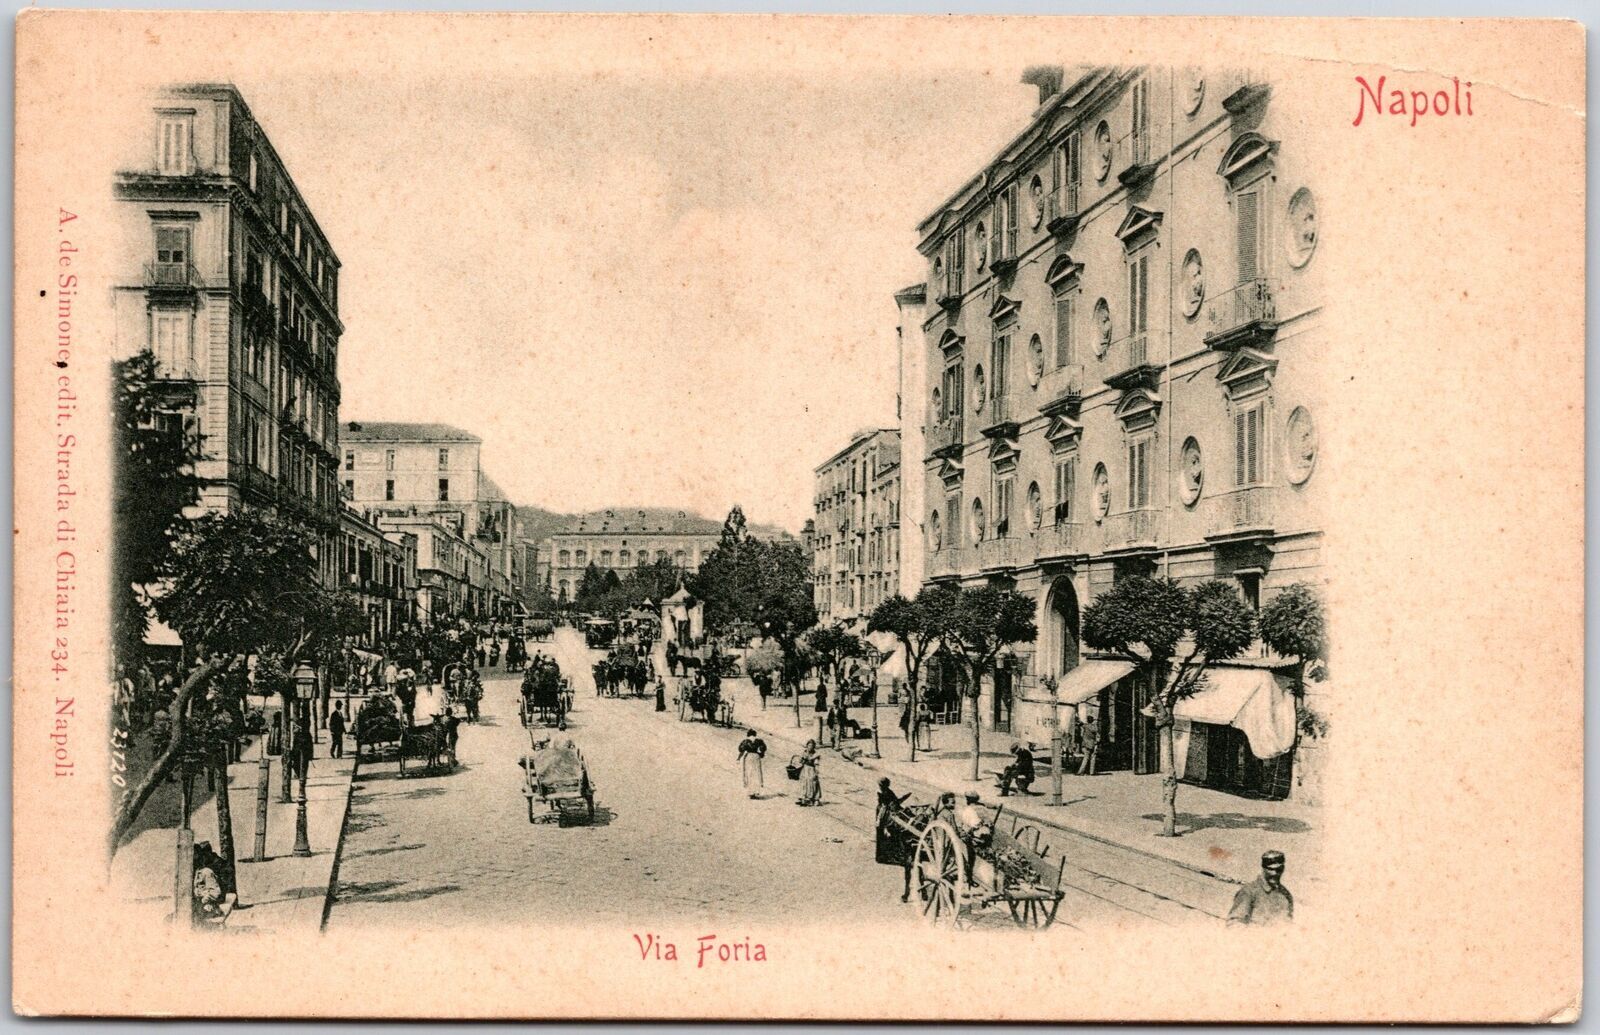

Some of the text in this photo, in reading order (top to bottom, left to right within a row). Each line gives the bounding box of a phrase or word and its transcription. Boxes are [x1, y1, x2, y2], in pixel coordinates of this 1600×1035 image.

[1352, 75, 1474, 128] Napoli
[57, 206, 78, 232] A.
[57, 240, 79, 266] de
[57, 375, 79, 427] edit.
[57, 433, 77, 511] Strada
[57, 520, 77, 542] di
[57, 551, 77, 628] Chiaia
[52, 637, 72, 682] 234.
[50, 698, 75, 777] Napoli
[633, 933, 767, 969] Via Foria
